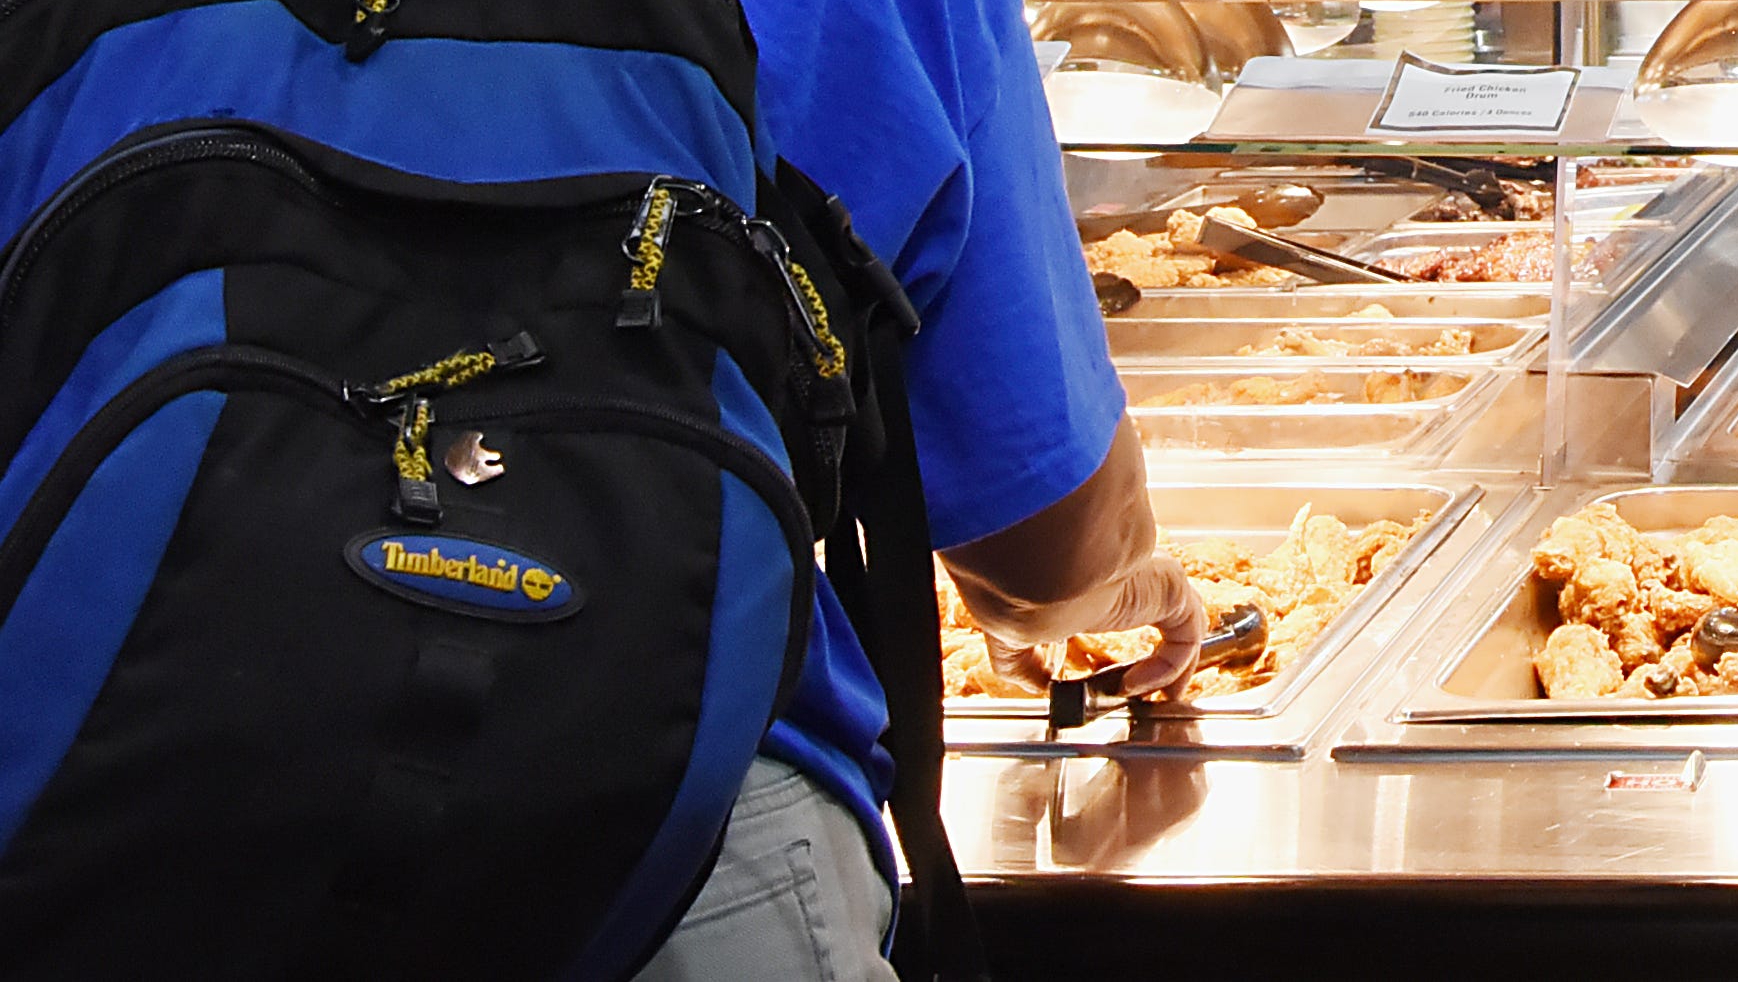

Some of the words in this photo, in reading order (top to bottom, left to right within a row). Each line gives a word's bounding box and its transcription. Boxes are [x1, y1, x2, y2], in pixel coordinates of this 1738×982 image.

[1443, 85, 1476, 93] Fried
[1479, 84, 1526, 93] Chicken
[381, 541, 519, 592] Timberland
